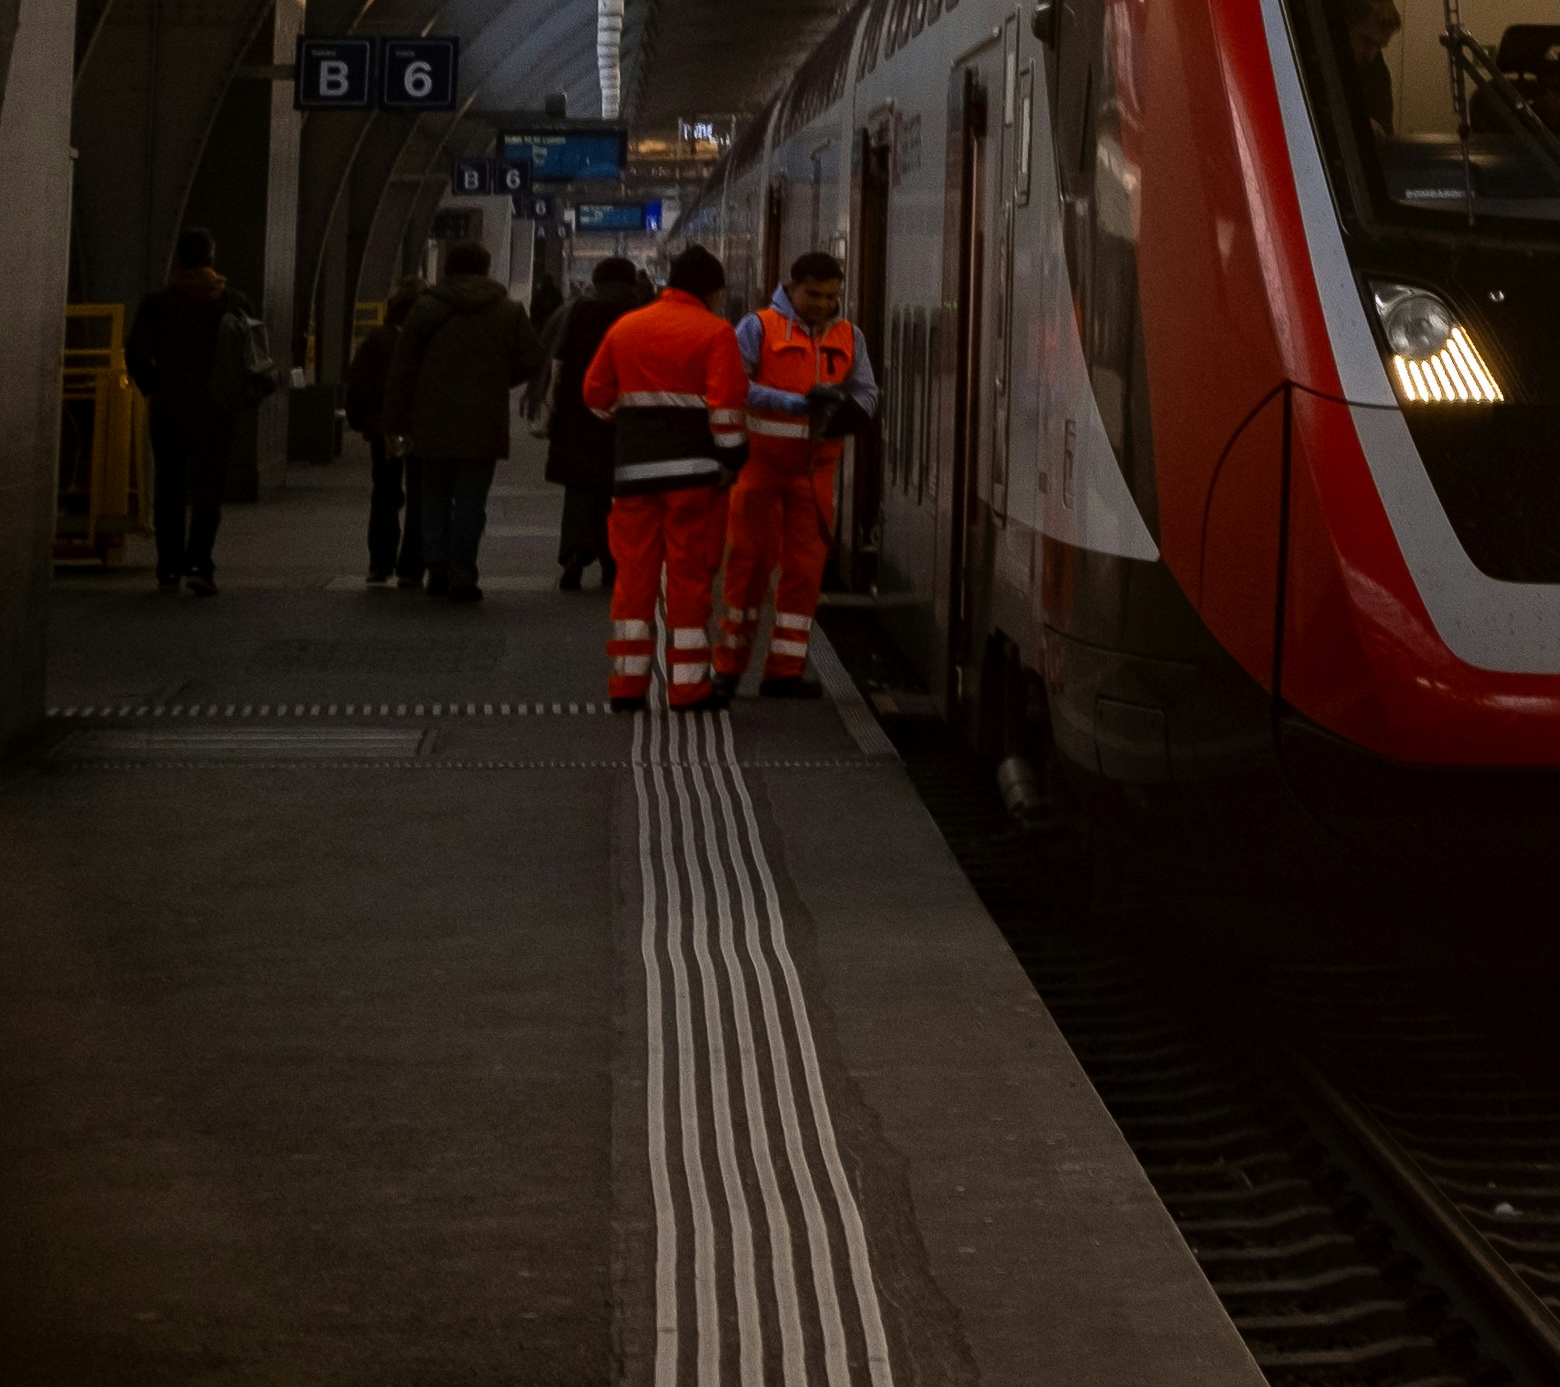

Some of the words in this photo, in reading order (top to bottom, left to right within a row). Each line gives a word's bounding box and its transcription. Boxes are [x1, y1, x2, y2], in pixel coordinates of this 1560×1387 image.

[319, 60, 349, 97] B
[404, 60, 433, 98] 6
[464, 170, 479, 190] B
[506, 169, 521, 189] 6
